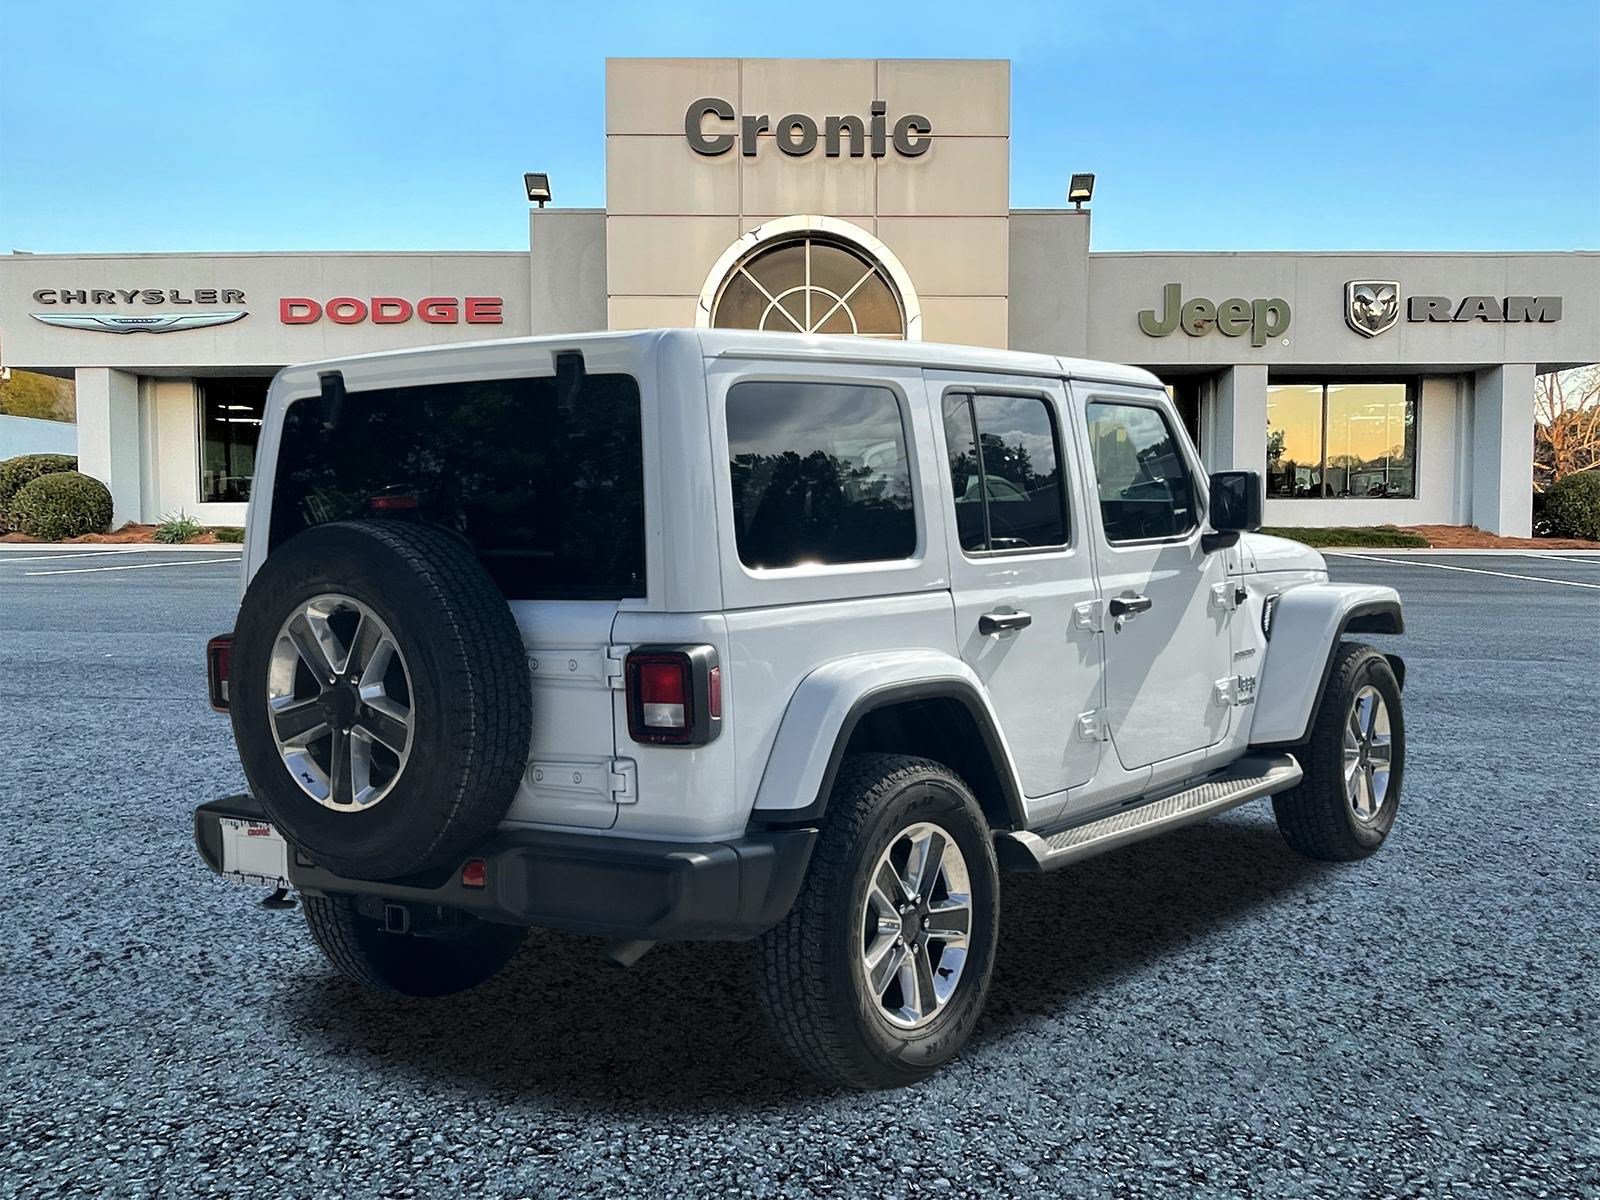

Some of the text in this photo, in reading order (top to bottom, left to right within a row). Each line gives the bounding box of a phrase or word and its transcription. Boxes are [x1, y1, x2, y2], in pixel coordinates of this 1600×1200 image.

[684, 97, 933, 157] Cronic
[32, 287, 247, 305] CHRYSLER
[279, 296, 504, 325] DODGE
[1407, 296, 1563, 322] RAM
[1138, 283, 1292, 347] Jeep
